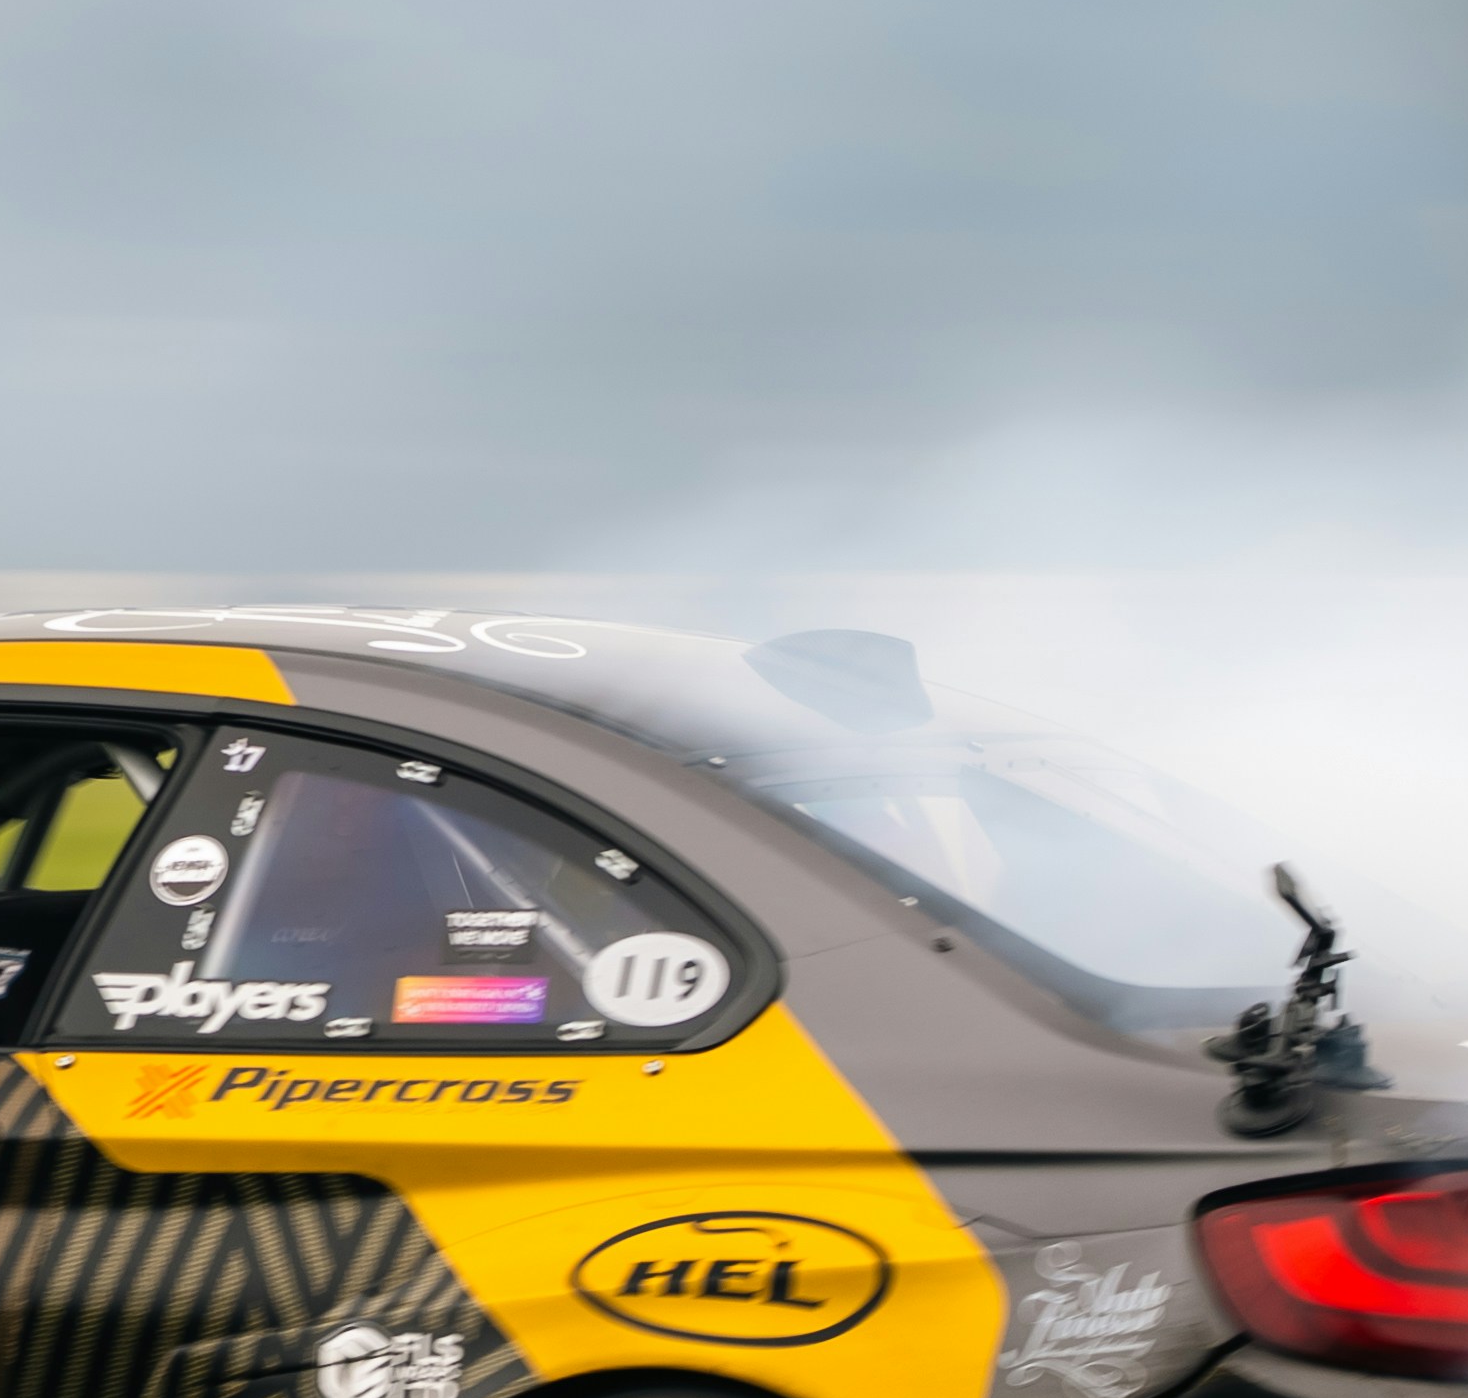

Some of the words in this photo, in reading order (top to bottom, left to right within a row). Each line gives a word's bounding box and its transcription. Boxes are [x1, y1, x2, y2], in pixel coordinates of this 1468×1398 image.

[614, 954, 705, 1003] 119
[210, 1066, 585, 1113] Pipercross
[616, 1258, 830, 1312] HEL
